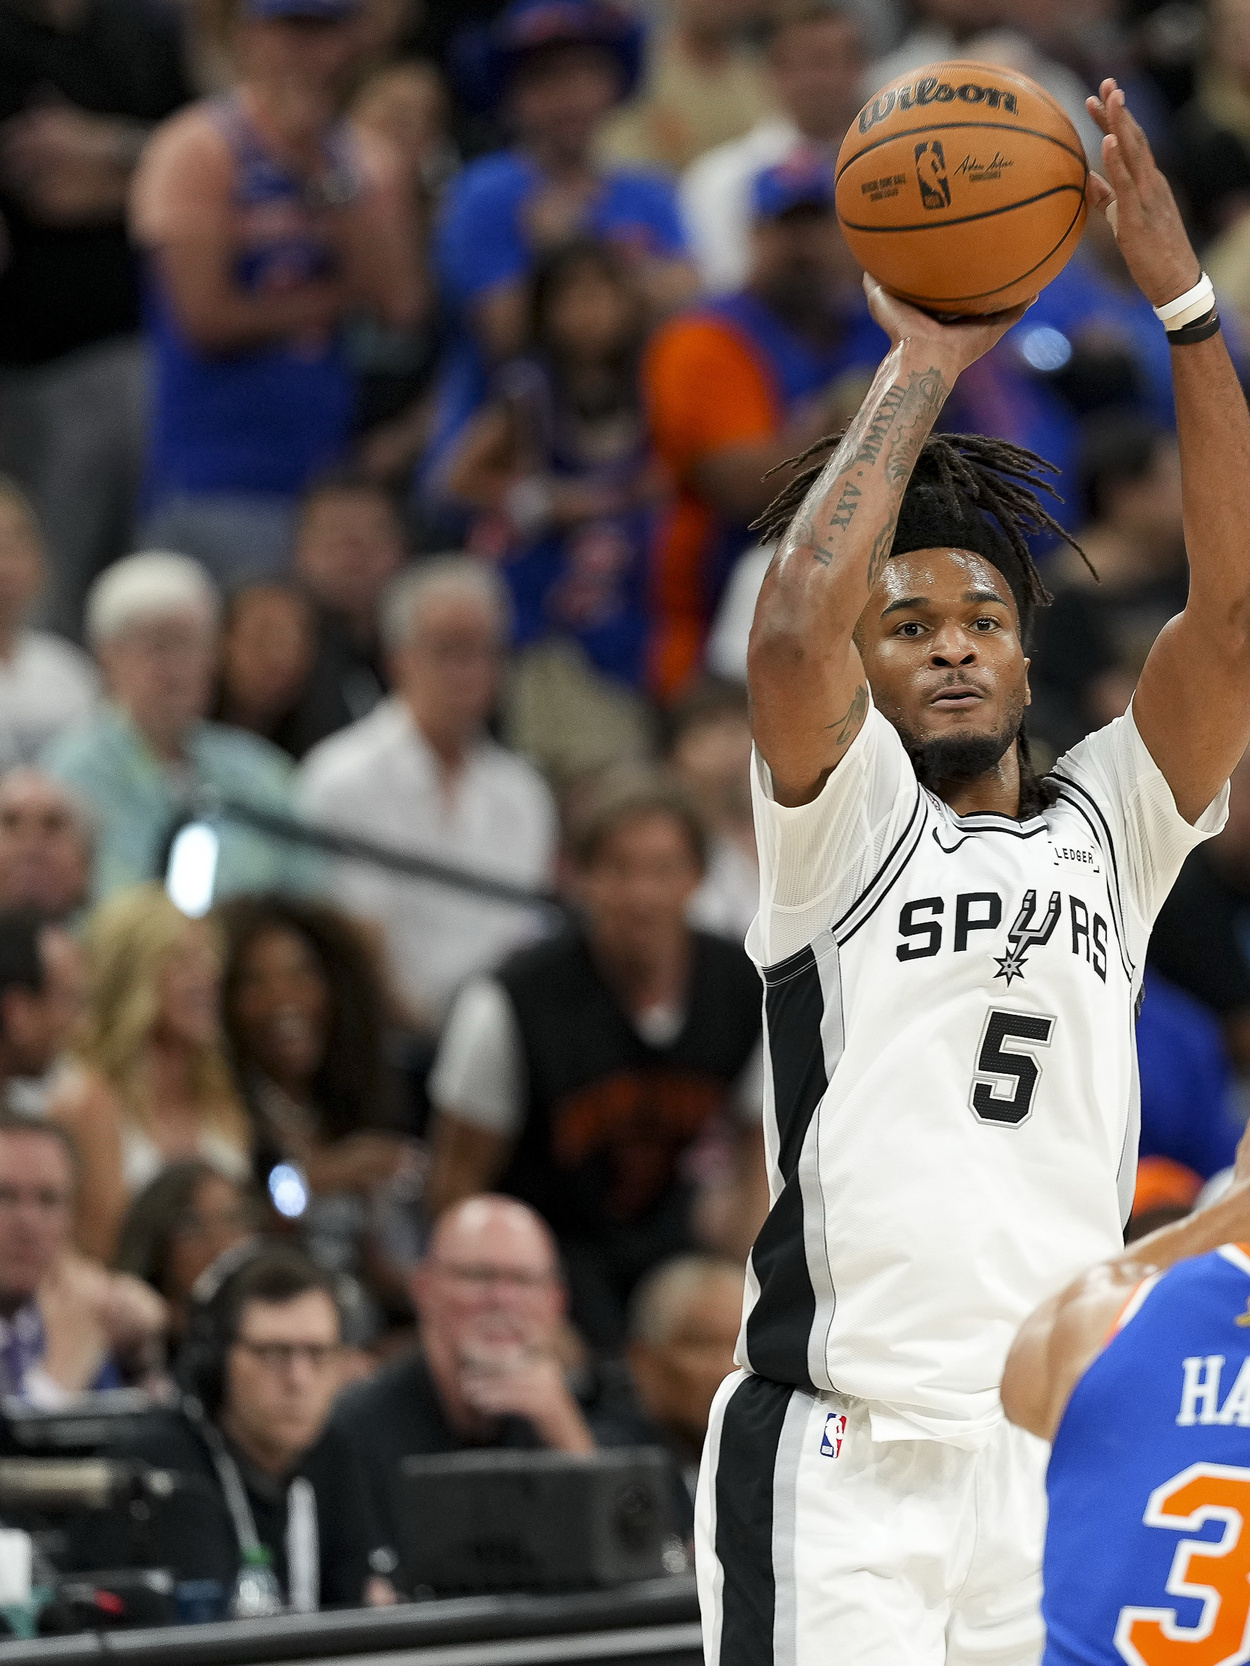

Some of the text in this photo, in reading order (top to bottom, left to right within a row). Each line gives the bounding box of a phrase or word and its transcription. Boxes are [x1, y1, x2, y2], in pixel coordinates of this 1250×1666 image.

[858, 77, 1018, 134] Wilson
[829, 481, 862, 531] XXV
[1054, 847, 1094, 864] LEDGER
[896, 889, 1108, 987] SPURS
[968, 1005, 1057, 1129] 5
